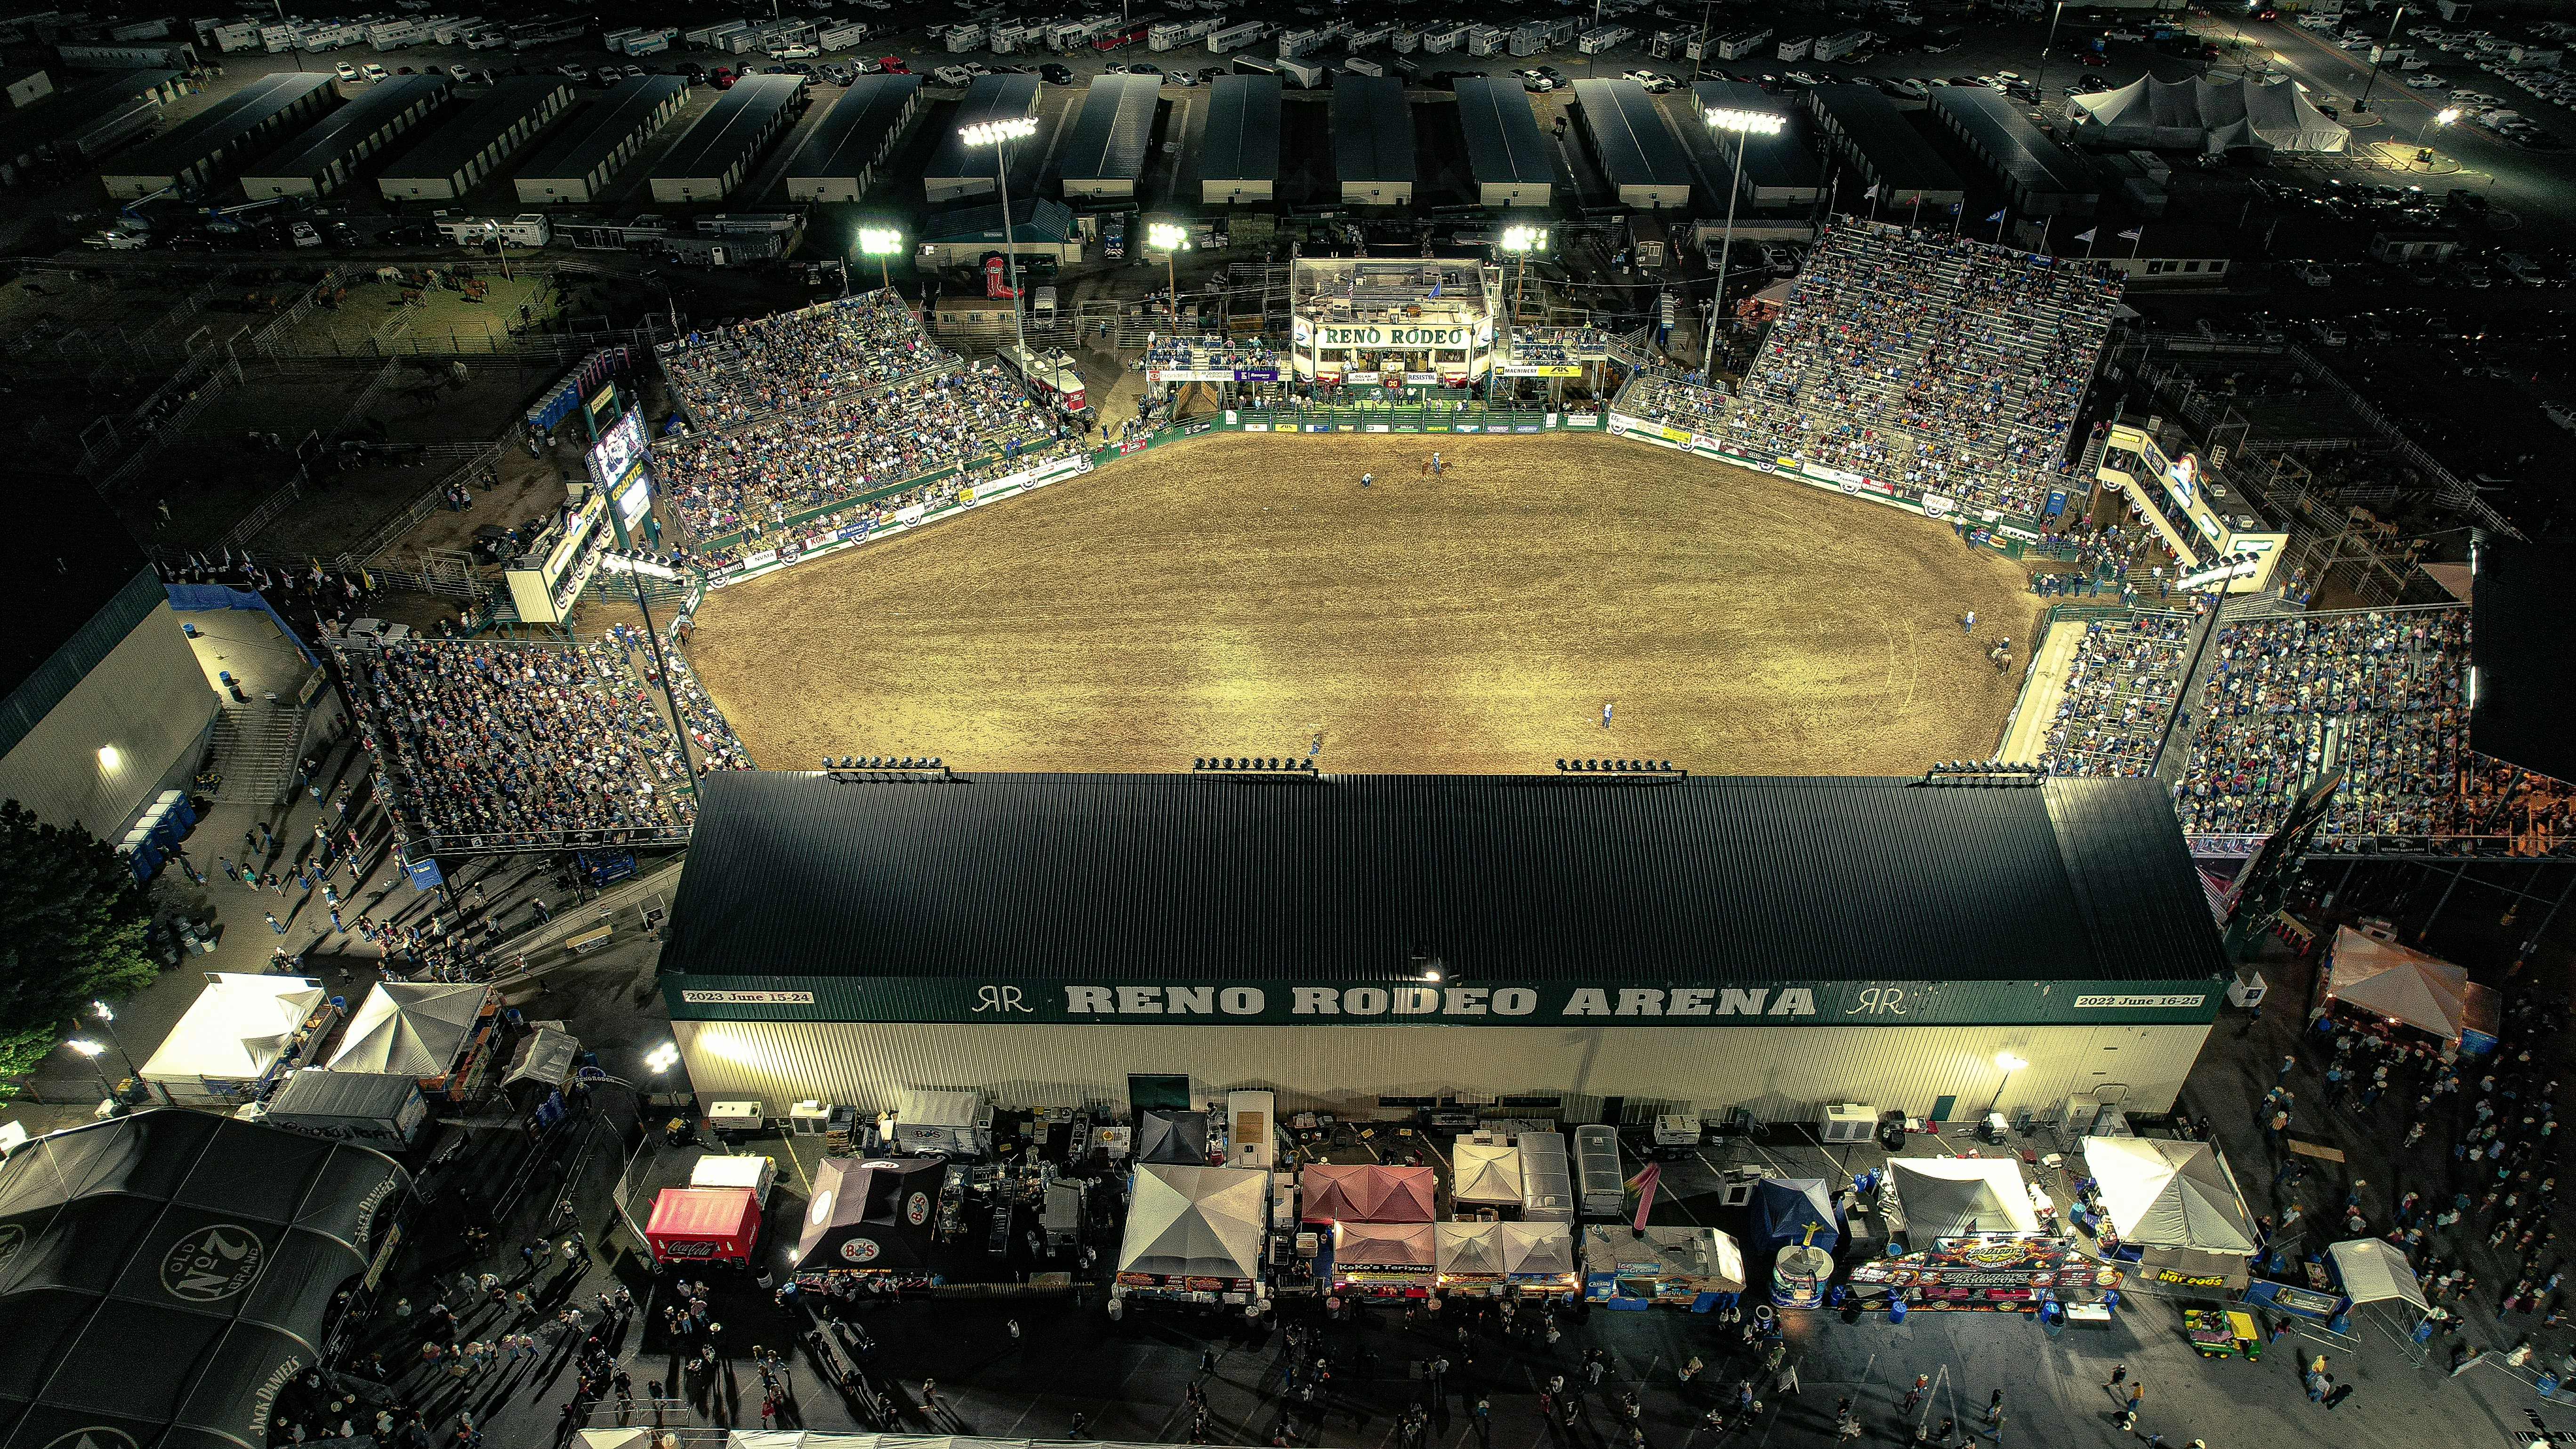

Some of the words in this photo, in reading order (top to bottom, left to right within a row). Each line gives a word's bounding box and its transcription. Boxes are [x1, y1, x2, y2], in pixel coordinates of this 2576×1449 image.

[1326, 329, 1381, 344] RENO
[1391, 329, 1463, 344] RODEO
[612, 462, 643, 501] GRANITE
[1925, 495, 1949, 507] Coca-Cola
[755, 553, 774, 562] NVMA
[707, 570, 722, 580] JACK
[721, 562, 744, 575] DANIEL'S
[687, 992, 724, 1002] 2023
[728, 993, 765, 1002] June
[769, 993, 811, 1003] 15-24
[1065, 986, 1265, 1015] RENO
[1292, 987, 1538, 1015] RODEO
[1562, 988, 1817, 1016] ARENA
[2078, 997, 2116, 1006] 2022
[2118, 997, 2155, 1006] June
[2159, 996, 2200, 1006] 16-25
[201, 1230, 248, 1260] 7
[667, 1241, 715, 1256] Coca-Cola
[170, 1244, 195, 1272] OLD
[1972, 1258, 2014, 1267] BARBECUE
[227, 1248, 259, 1289] BRAND
[2159, 1272, 2187, 1283] HOT
[2187, 1277, 2223, 1286] DOGS
[256, 1355, 302, 1402] DANIEL'S
[249, 1400, 273, 1437] JACK
